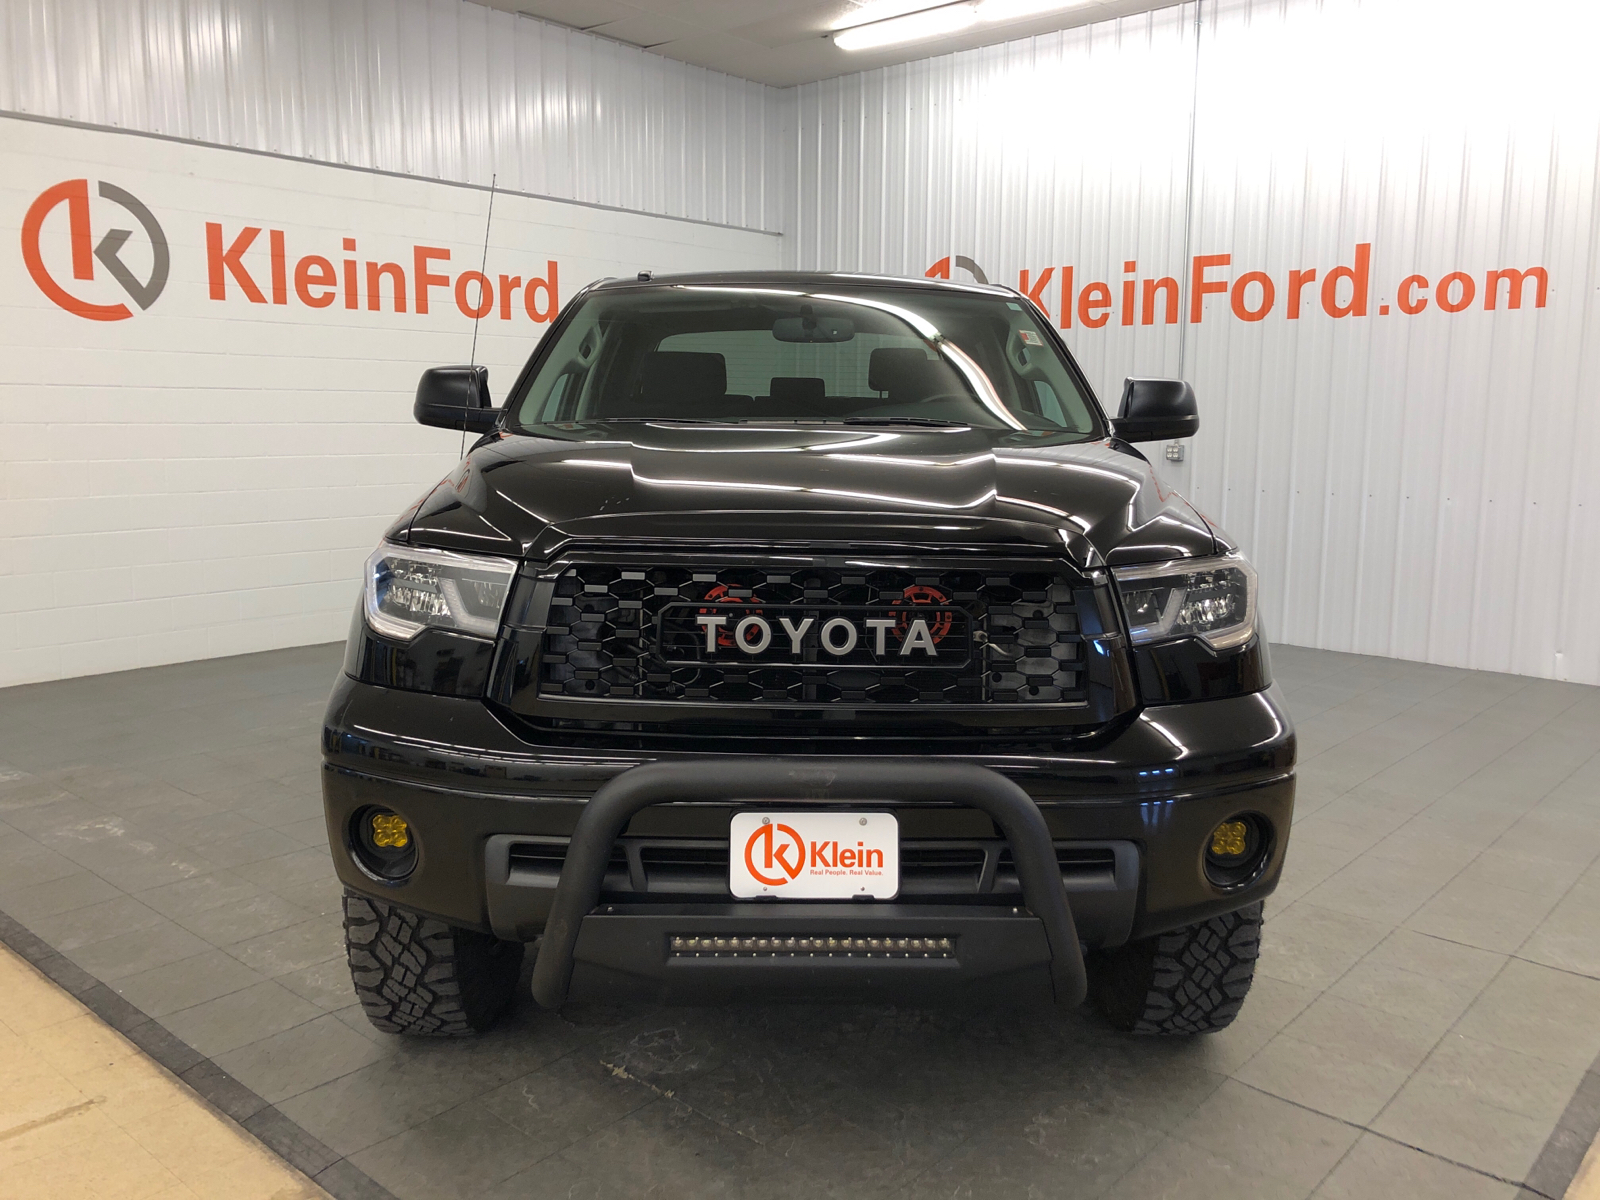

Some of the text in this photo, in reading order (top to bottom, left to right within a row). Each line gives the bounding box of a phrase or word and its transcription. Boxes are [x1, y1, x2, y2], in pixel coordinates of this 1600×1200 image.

[204, 221, 559, 324] KleinFord
[1018, 242, 1549, 330] KleinFord.com
[696, 615, 938, 656] TOYOTA
[810, 841, 884, 868] Klein
